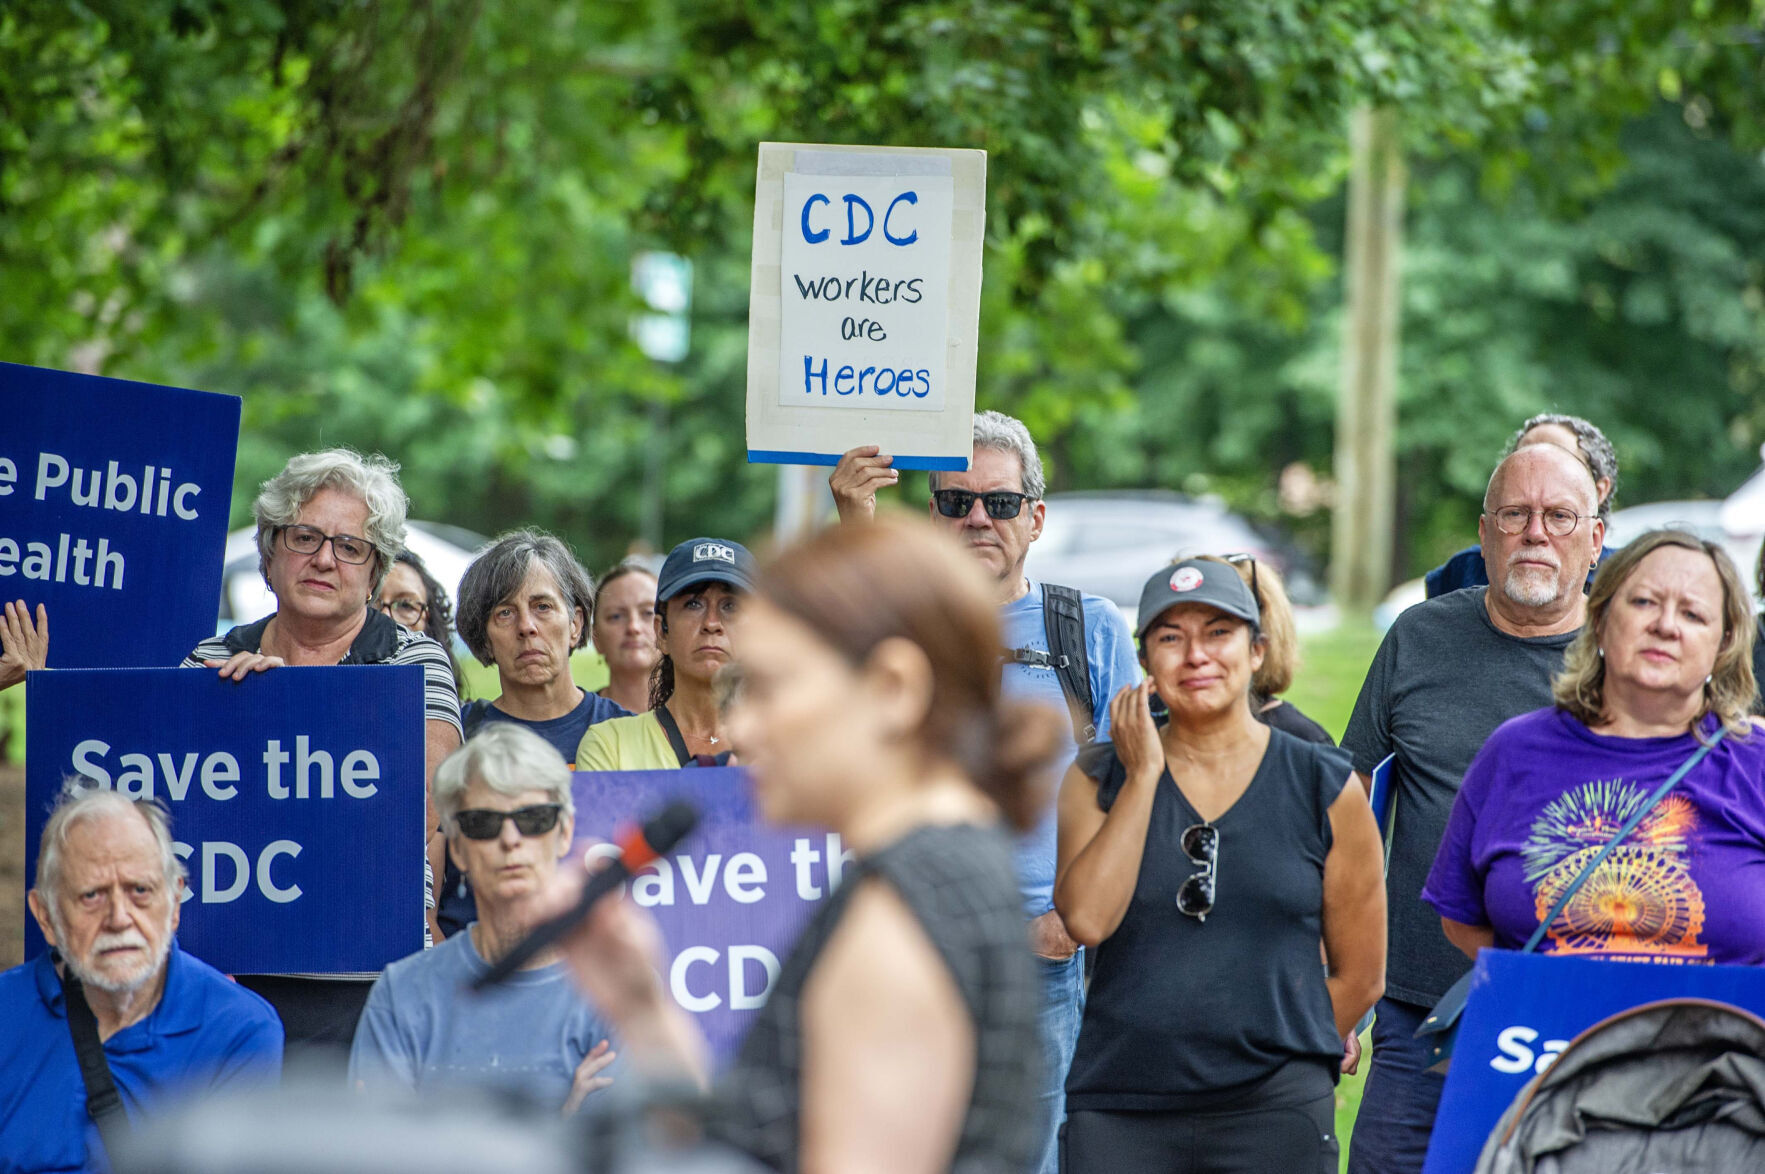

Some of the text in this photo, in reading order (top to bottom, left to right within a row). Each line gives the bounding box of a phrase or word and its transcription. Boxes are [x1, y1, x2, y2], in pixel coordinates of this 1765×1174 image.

[801, 191, 919, 246] CDC
[794, 270, 924, 304] workers
[841, 316, 887, 341] are
[803, 355, 931, 398] Heroes
[34, 452, 202, 520] Public
[695, 545, 733, 561] CDC
[71, 735, 380, 801] Save the
